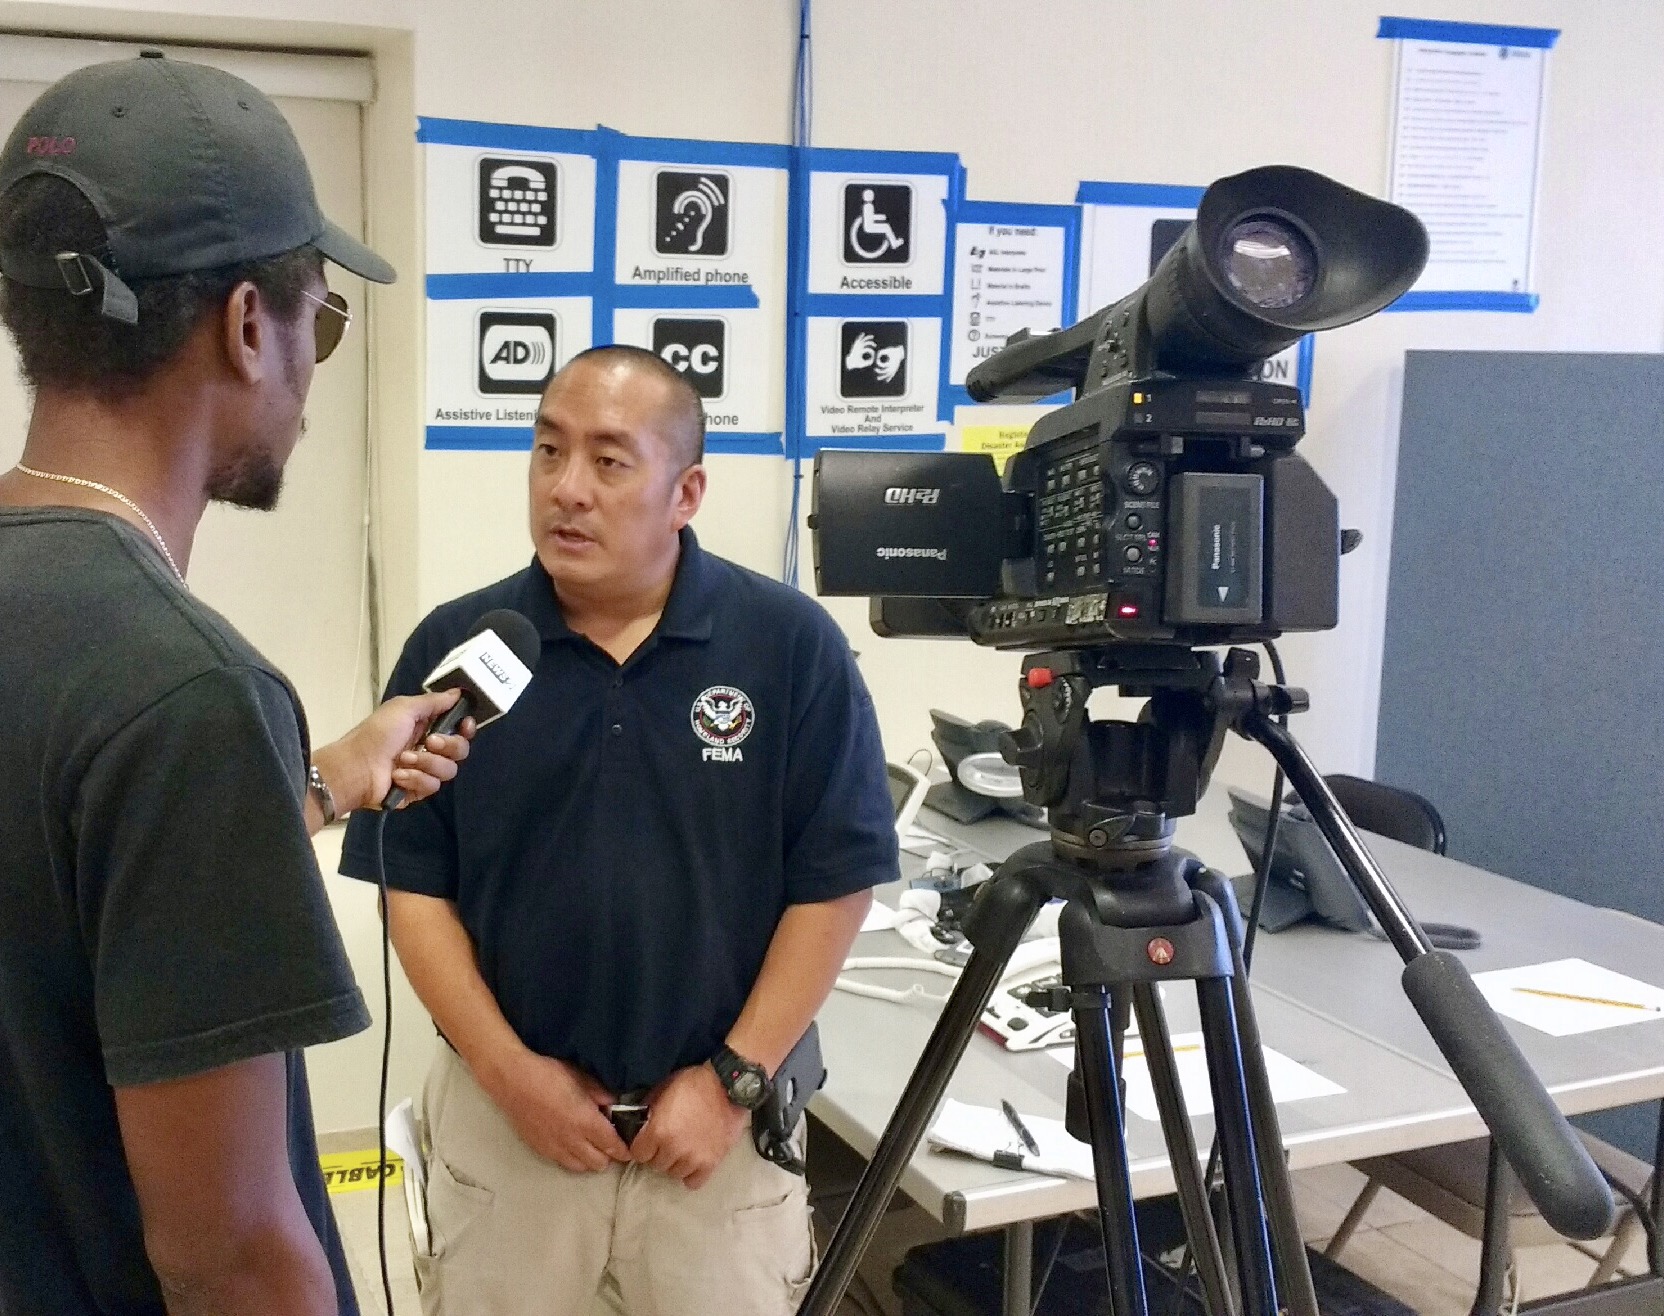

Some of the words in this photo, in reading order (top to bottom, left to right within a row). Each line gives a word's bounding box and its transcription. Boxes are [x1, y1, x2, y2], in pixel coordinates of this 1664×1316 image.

[503, 258, 533, 273] TTY
[633, 265, 701, 283] Amplified
[705, 268, 749, 286] phone
[840, 275, 913, 290] Accessible
[660, 343, 720, 374] CC
[435, 408, 493, 421] Assistive
[496, 408, 540, 421] Listeni
[821, 405, 845, 415] Video
[847, 405, 879, 414] Remote
[881, 404, 924, 415] Interpreter
[703, 412, 740, 426] hone
[864, 414, 882, 423] And
[831, 425, 855, 434] Video
[857, 424, 881, 435] Relay
[882, 423, 914, 432] Service
[876, 547, 947, 561] Panasonic
[1211, 524, 1221, 570] Panasonic
[701, 747, 744, 762] FEMA
